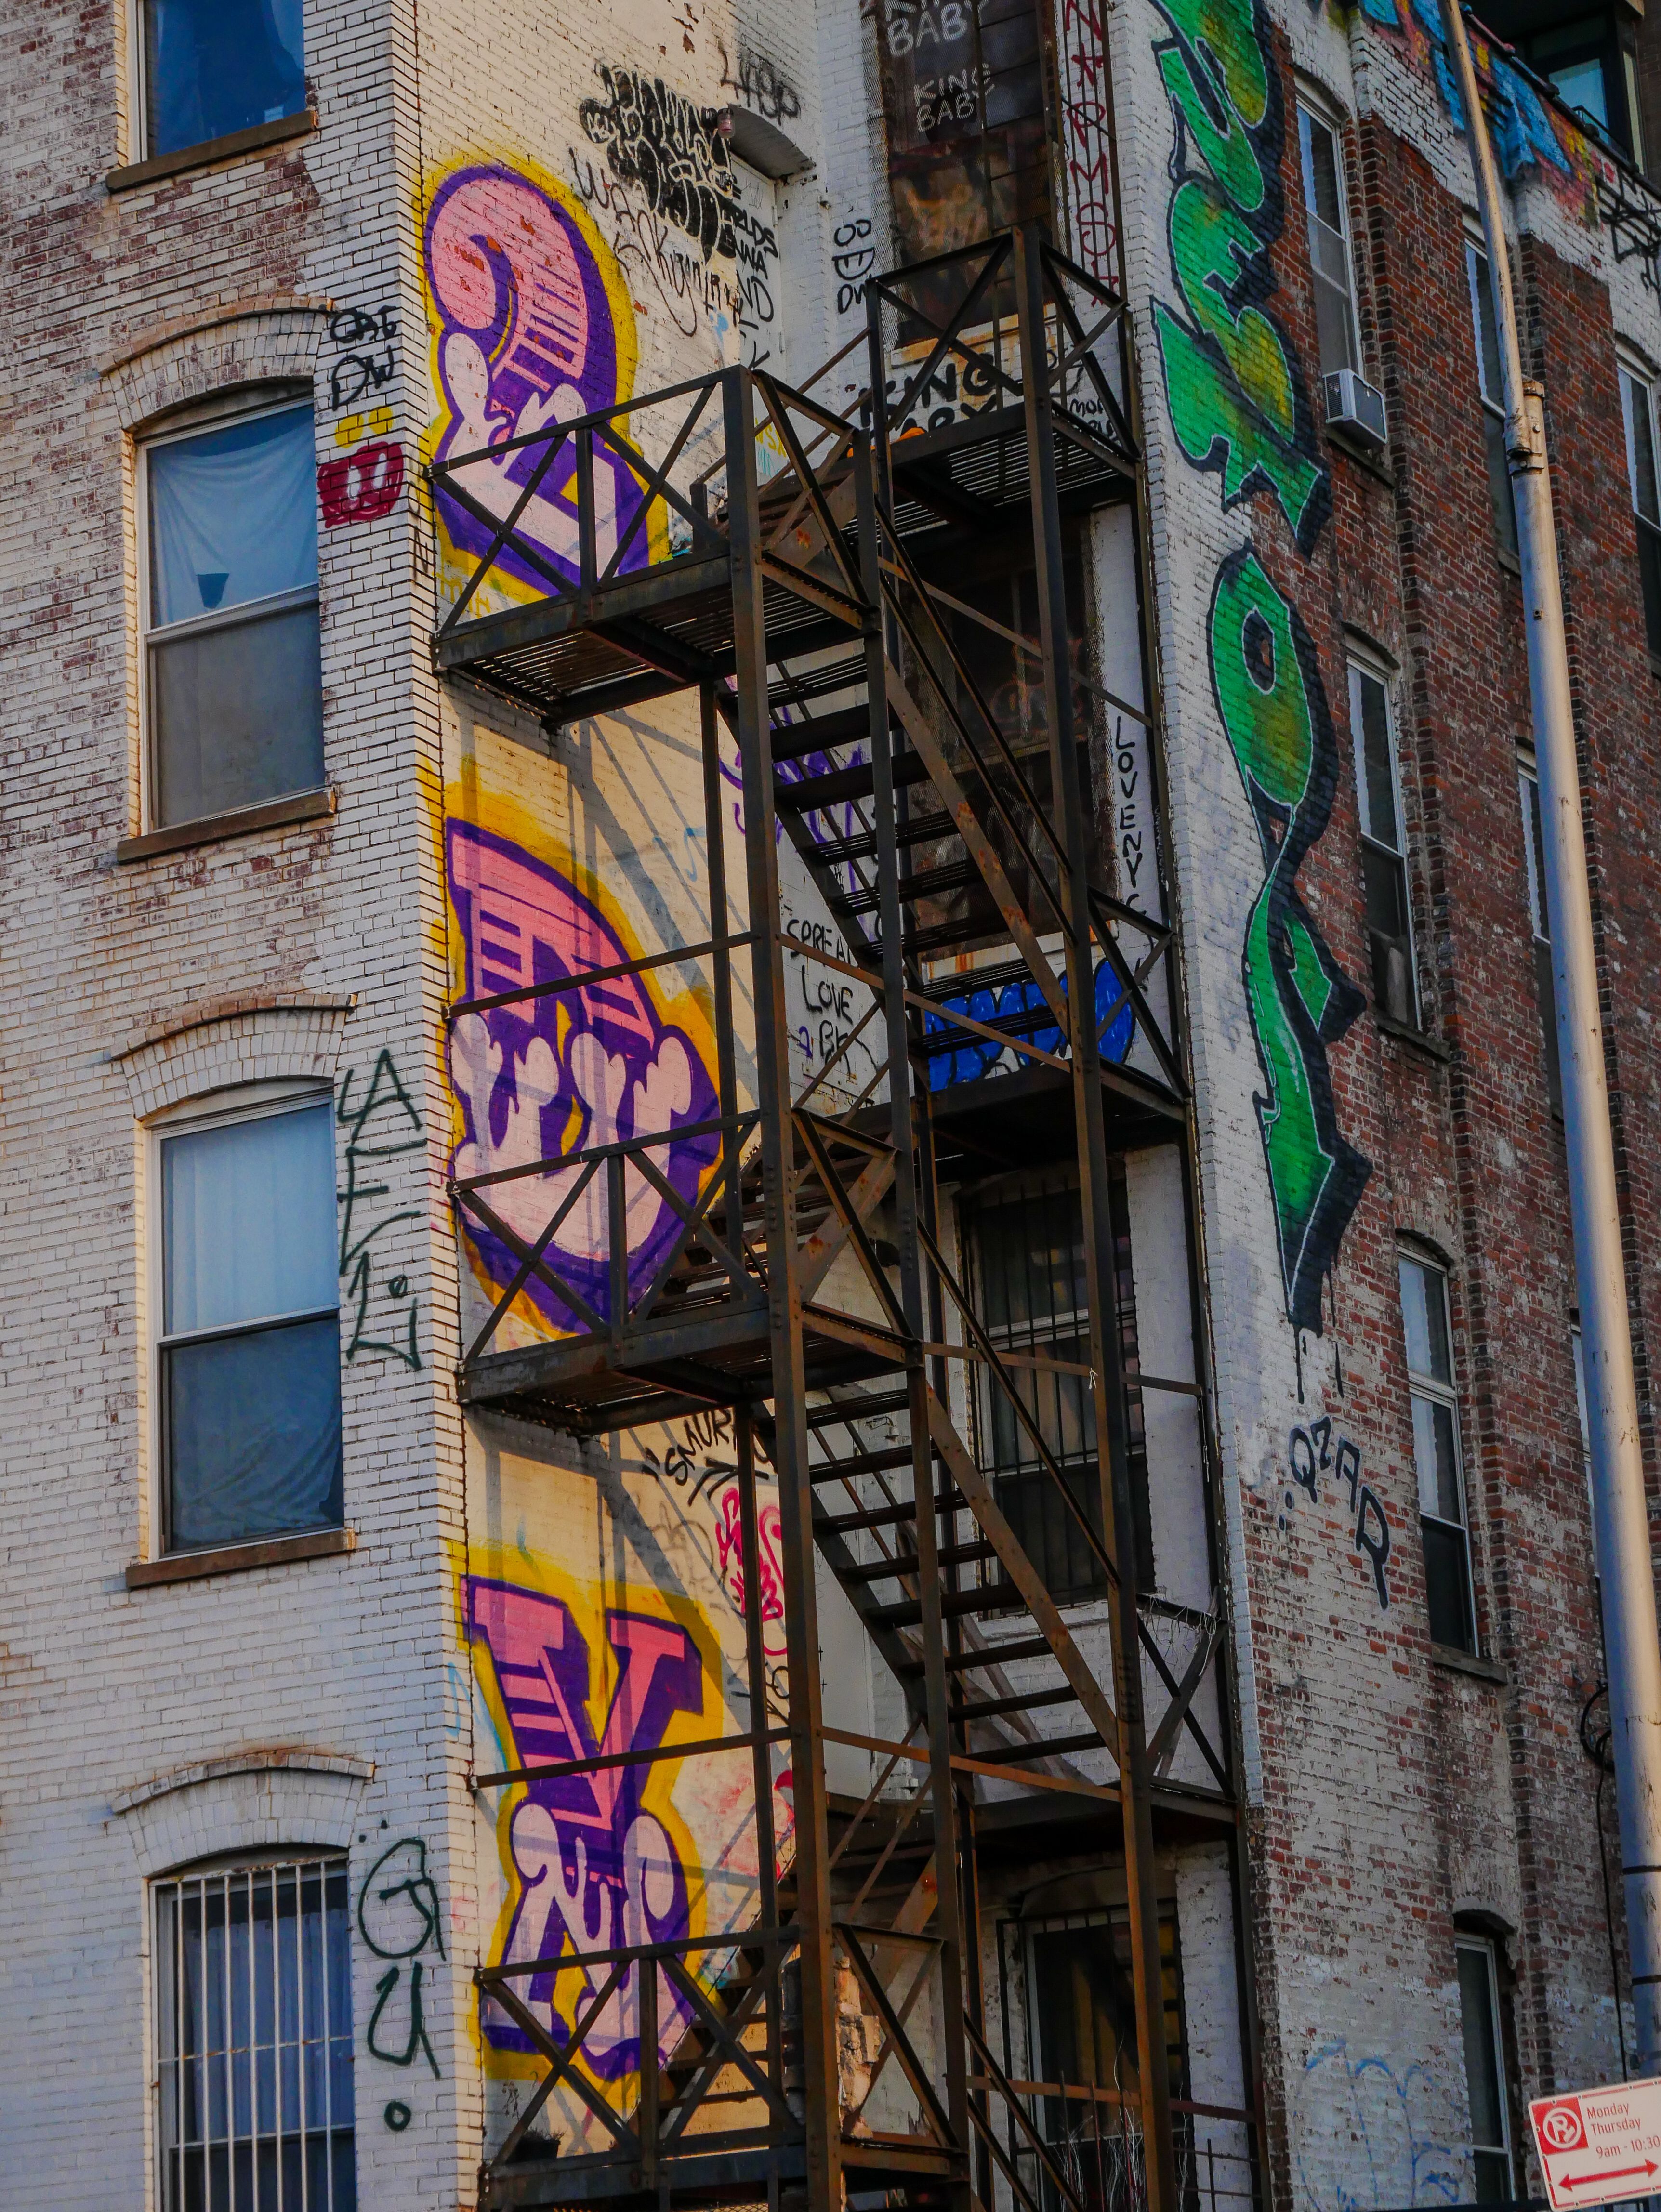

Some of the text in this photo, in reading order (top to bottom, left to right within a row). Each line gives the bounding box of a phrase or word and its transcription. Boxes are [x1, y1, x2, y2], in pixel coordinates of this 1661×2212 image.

[802, 964, 854, 1025] LOVE
[1587, 2102, 1629, 2120] Monday
[1591, 2117, 1641, 2136] Thursday
[1595, 2145, 1621, 2159] 9am
